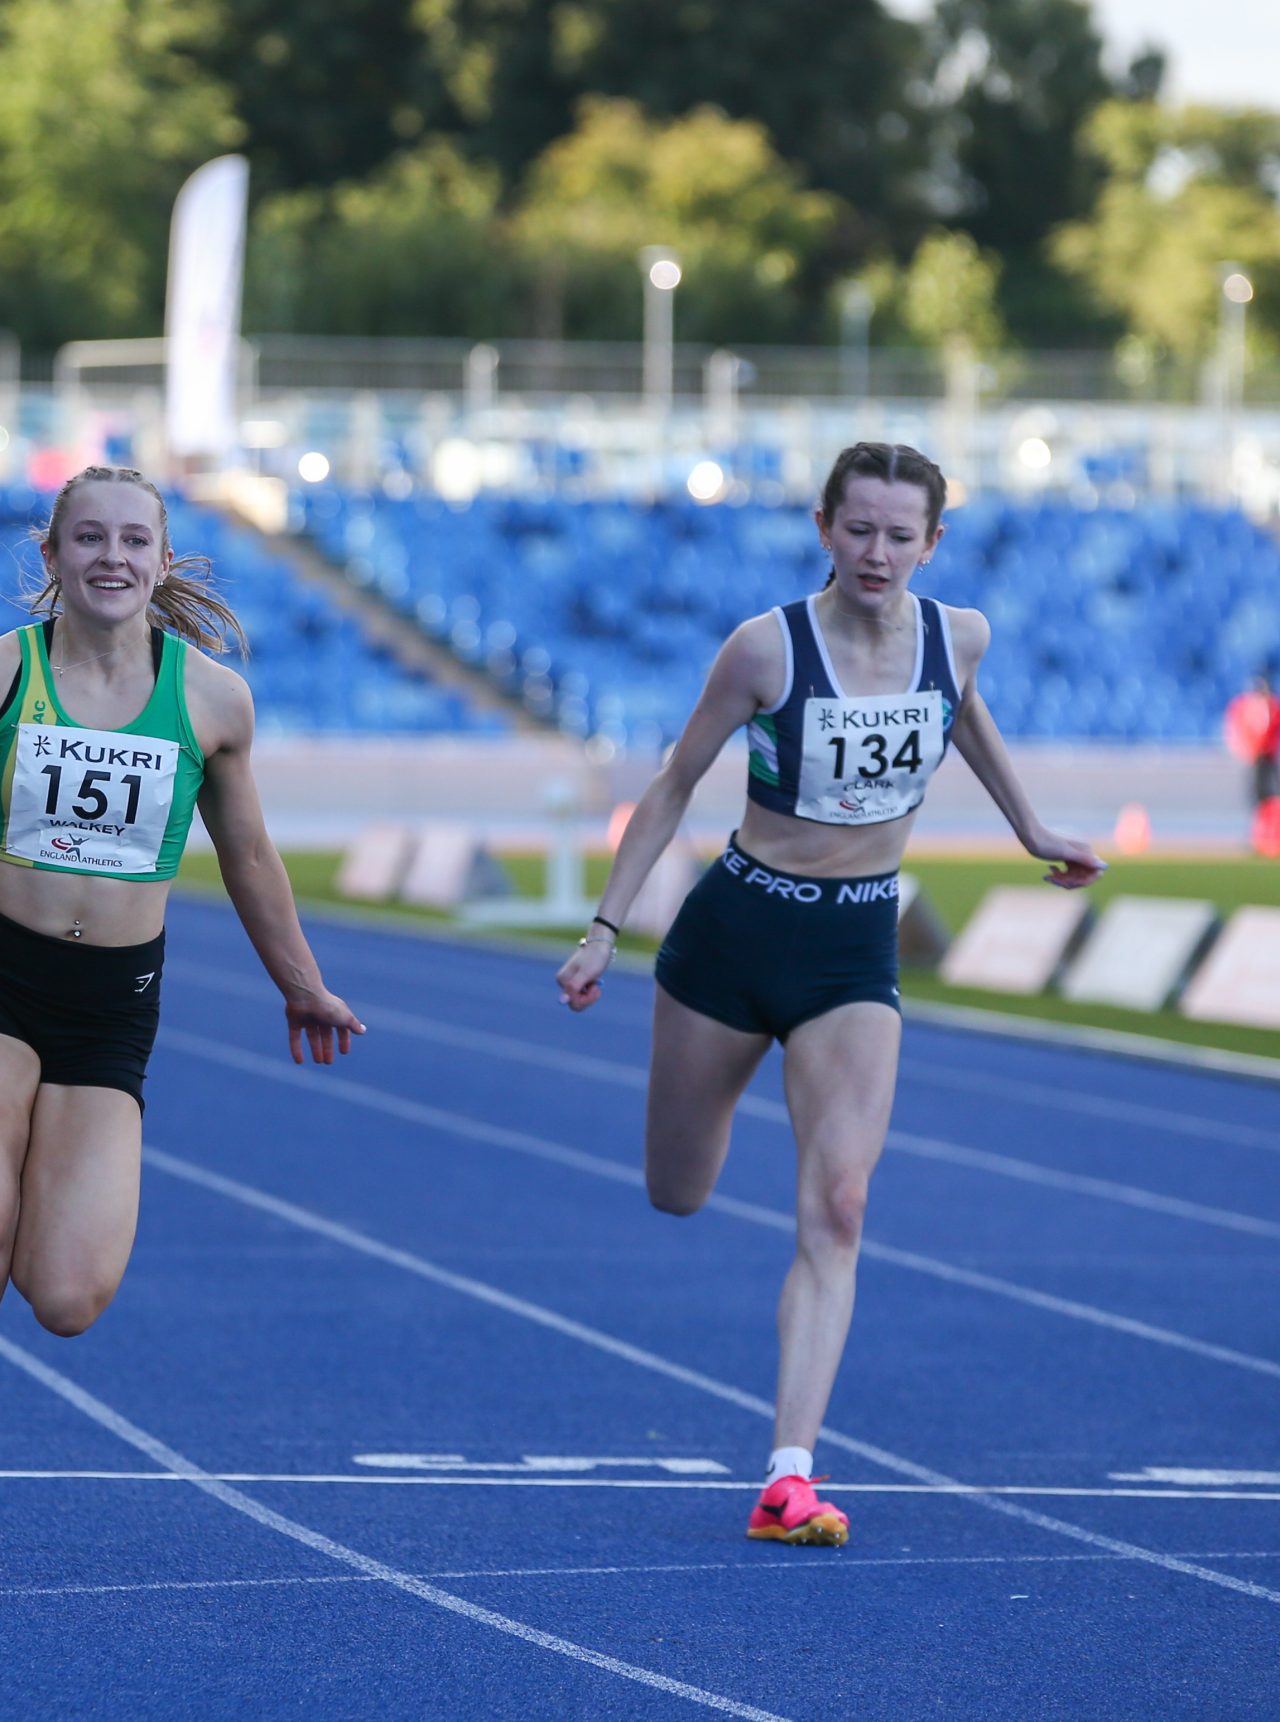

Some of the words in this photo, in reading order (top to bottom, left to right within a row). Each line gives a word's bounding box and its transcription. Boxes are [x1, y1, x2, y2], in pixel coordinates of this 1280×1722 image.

[32, 700, 46, 724] AC
[842, 708, 929, 729] KUKRI
[59, 739, 162, 771] KUKRI
[828, 729, 923, 779] 134
[40, 764, 142, 825] 151
[49, 819, 126, 837] WALKEY
[39, 850, 78, 863] ENGLAND
[81, 857, 123, 868] ATHLETICS
[744, 867, 823, 903] PRO
[835, 875, 899, 904] NIKE
